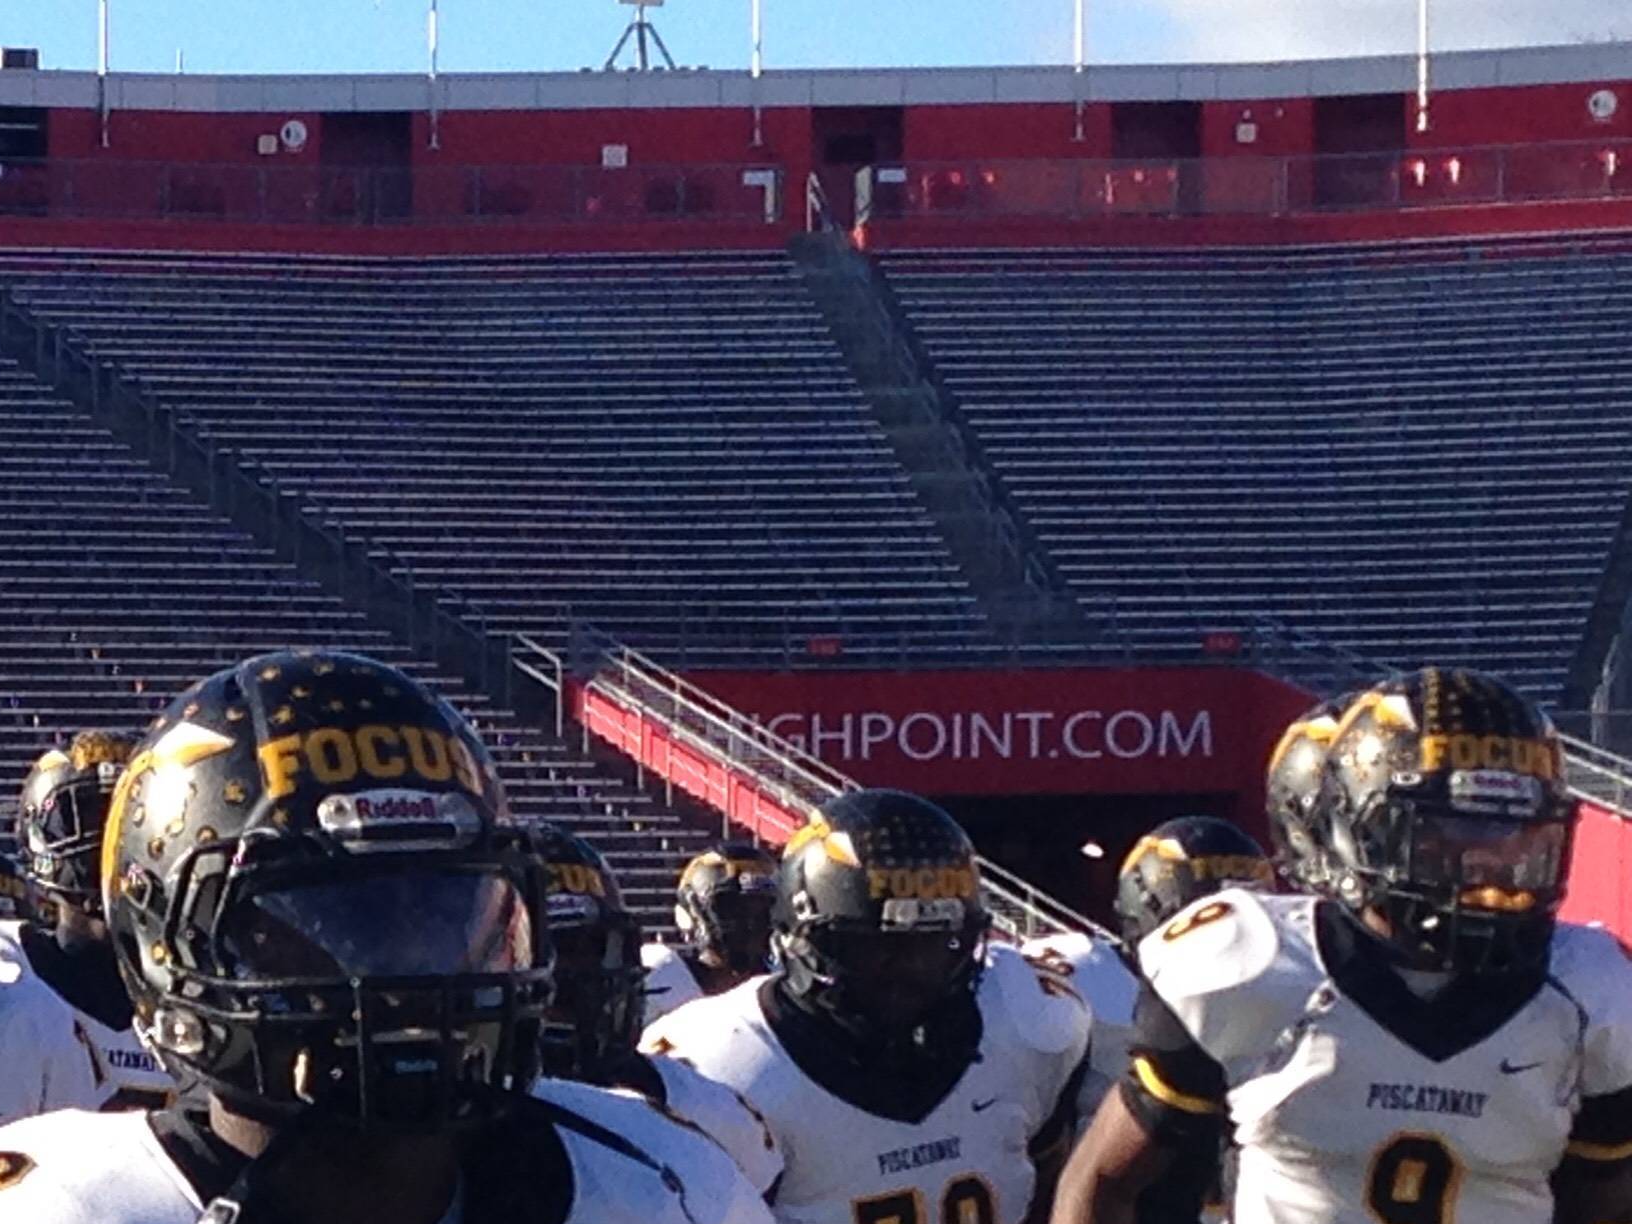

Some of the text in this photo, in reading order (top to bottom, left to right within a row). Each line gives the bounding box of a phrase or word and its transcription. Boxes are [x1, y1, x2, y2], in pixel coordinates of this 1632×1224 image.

[730, 710, 1213, 760] GHPOINT.COM
[257, 726, 484, 799] FOCUS
[355, 796, 437, 819] Riddell
